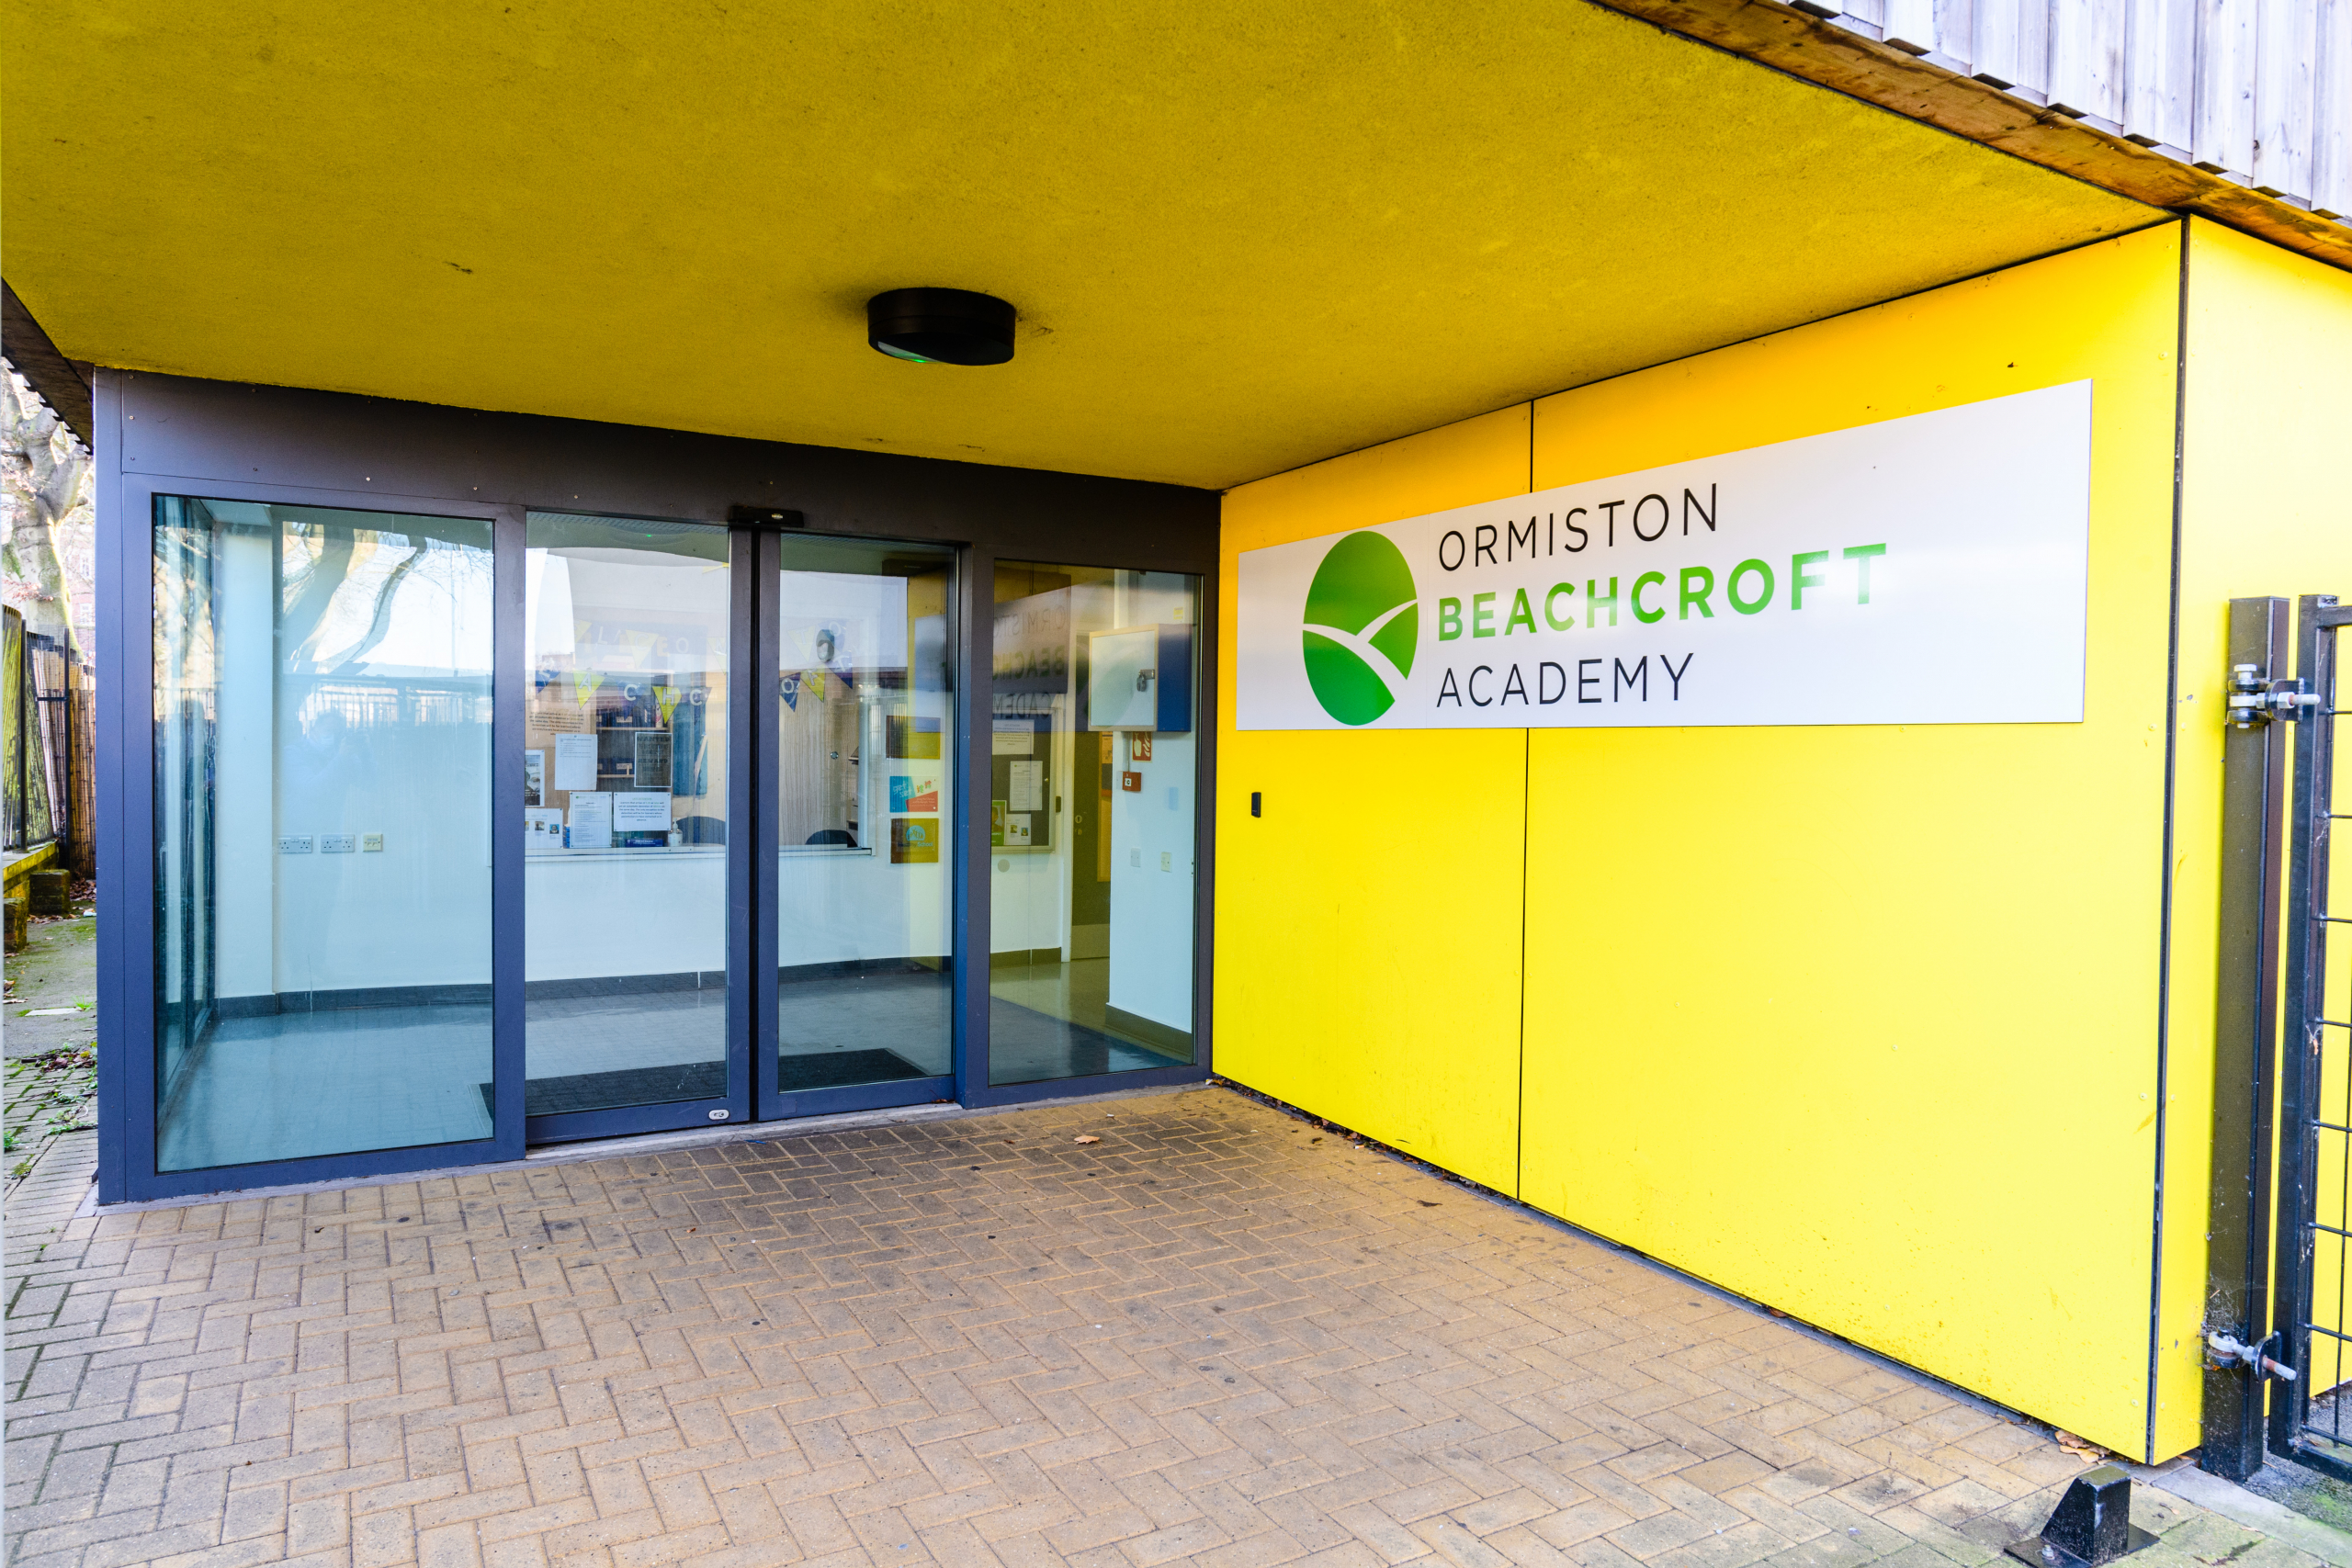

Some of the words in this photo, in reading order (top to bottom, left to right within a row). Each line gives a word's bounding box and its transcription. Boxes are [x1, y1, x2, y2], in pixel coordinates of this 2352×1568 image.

[1438, 482, 1718, 572] ORMISTON
[1437, 542, 1888, 642] BEACHCROFT
[1435, 651, 1696, 709] ACADEMY
